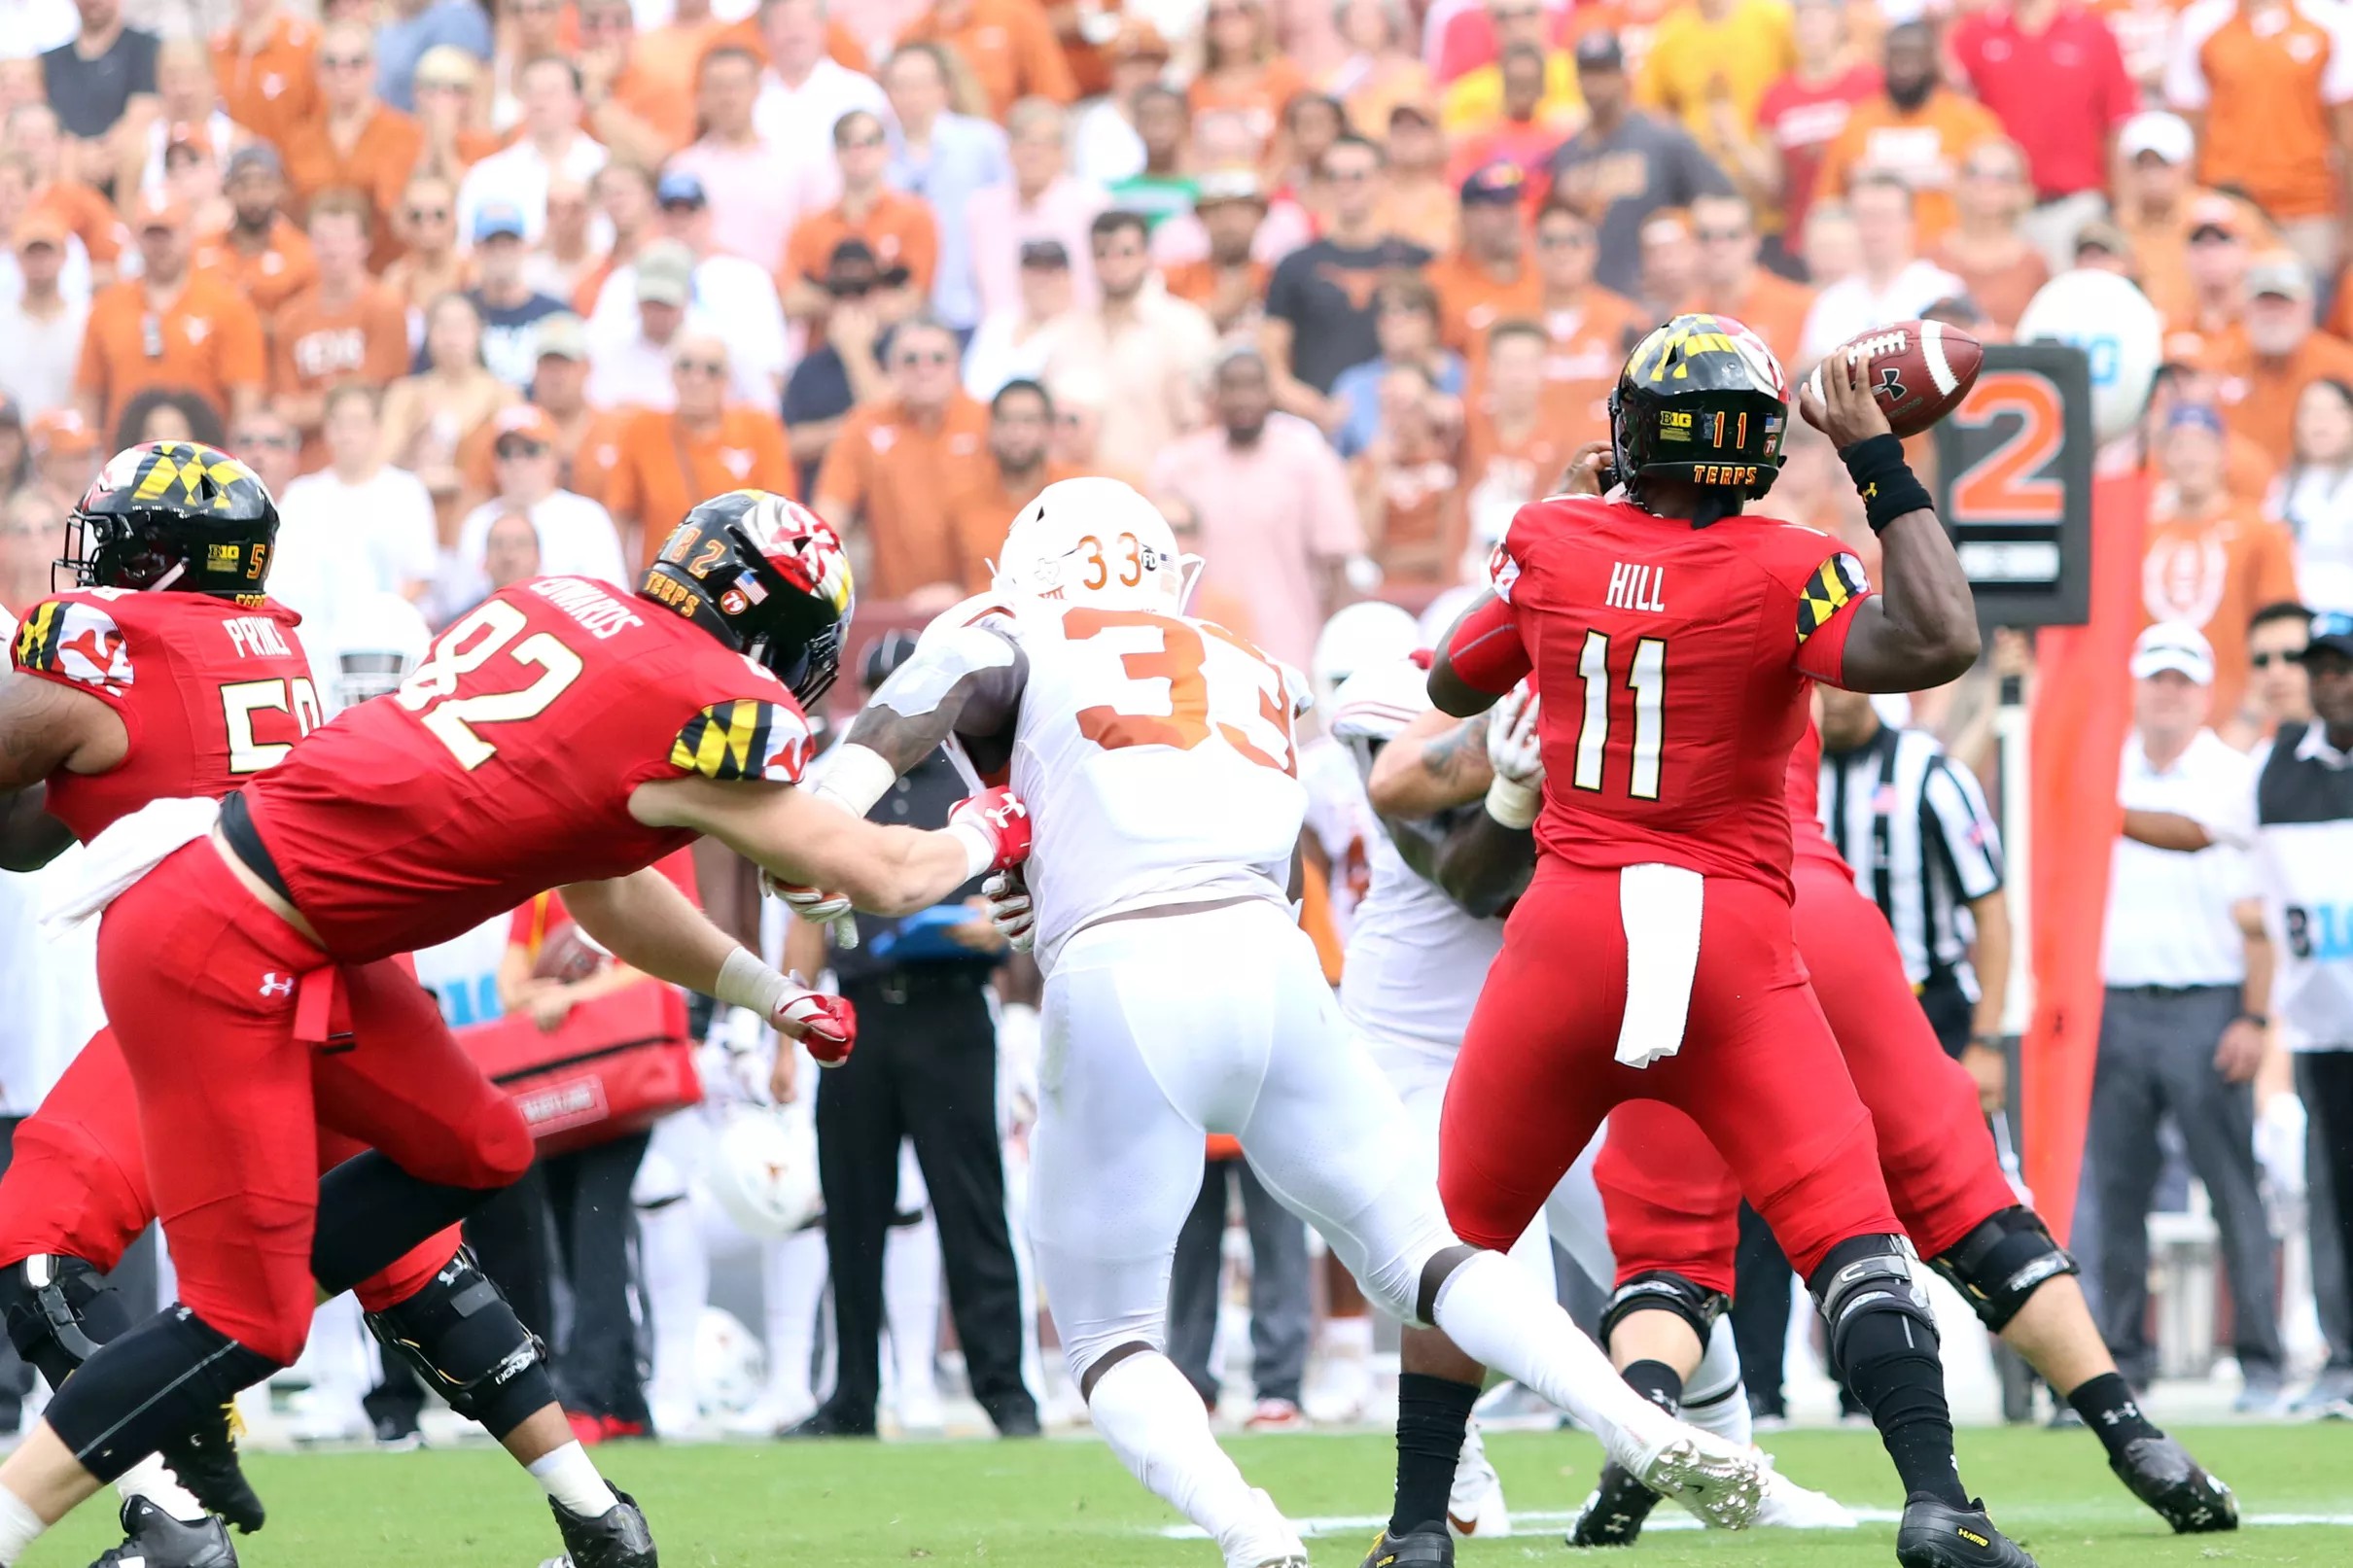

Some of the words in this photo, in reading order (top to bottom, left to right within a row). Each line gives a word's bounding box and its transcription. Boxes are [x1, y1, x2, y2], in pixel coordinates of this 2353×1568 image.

[1712, 410, 1747, 449] 11
[1950, 370, 2063, 523] 2
[1693, 465, 1758, 485] TERPS
[669, 527, 727, 579] 82
[1076, 532, 1141, 591] 33
[528, 577, 646, 641] EDWARDS
[644, 570, 701, 618] TERPS
[722, 591, 746, 612] 79
[1604, 561, 1666, 612] HILL
[393, 597, 584, 773] 82
[1571, 627, 1668, 803] 11
